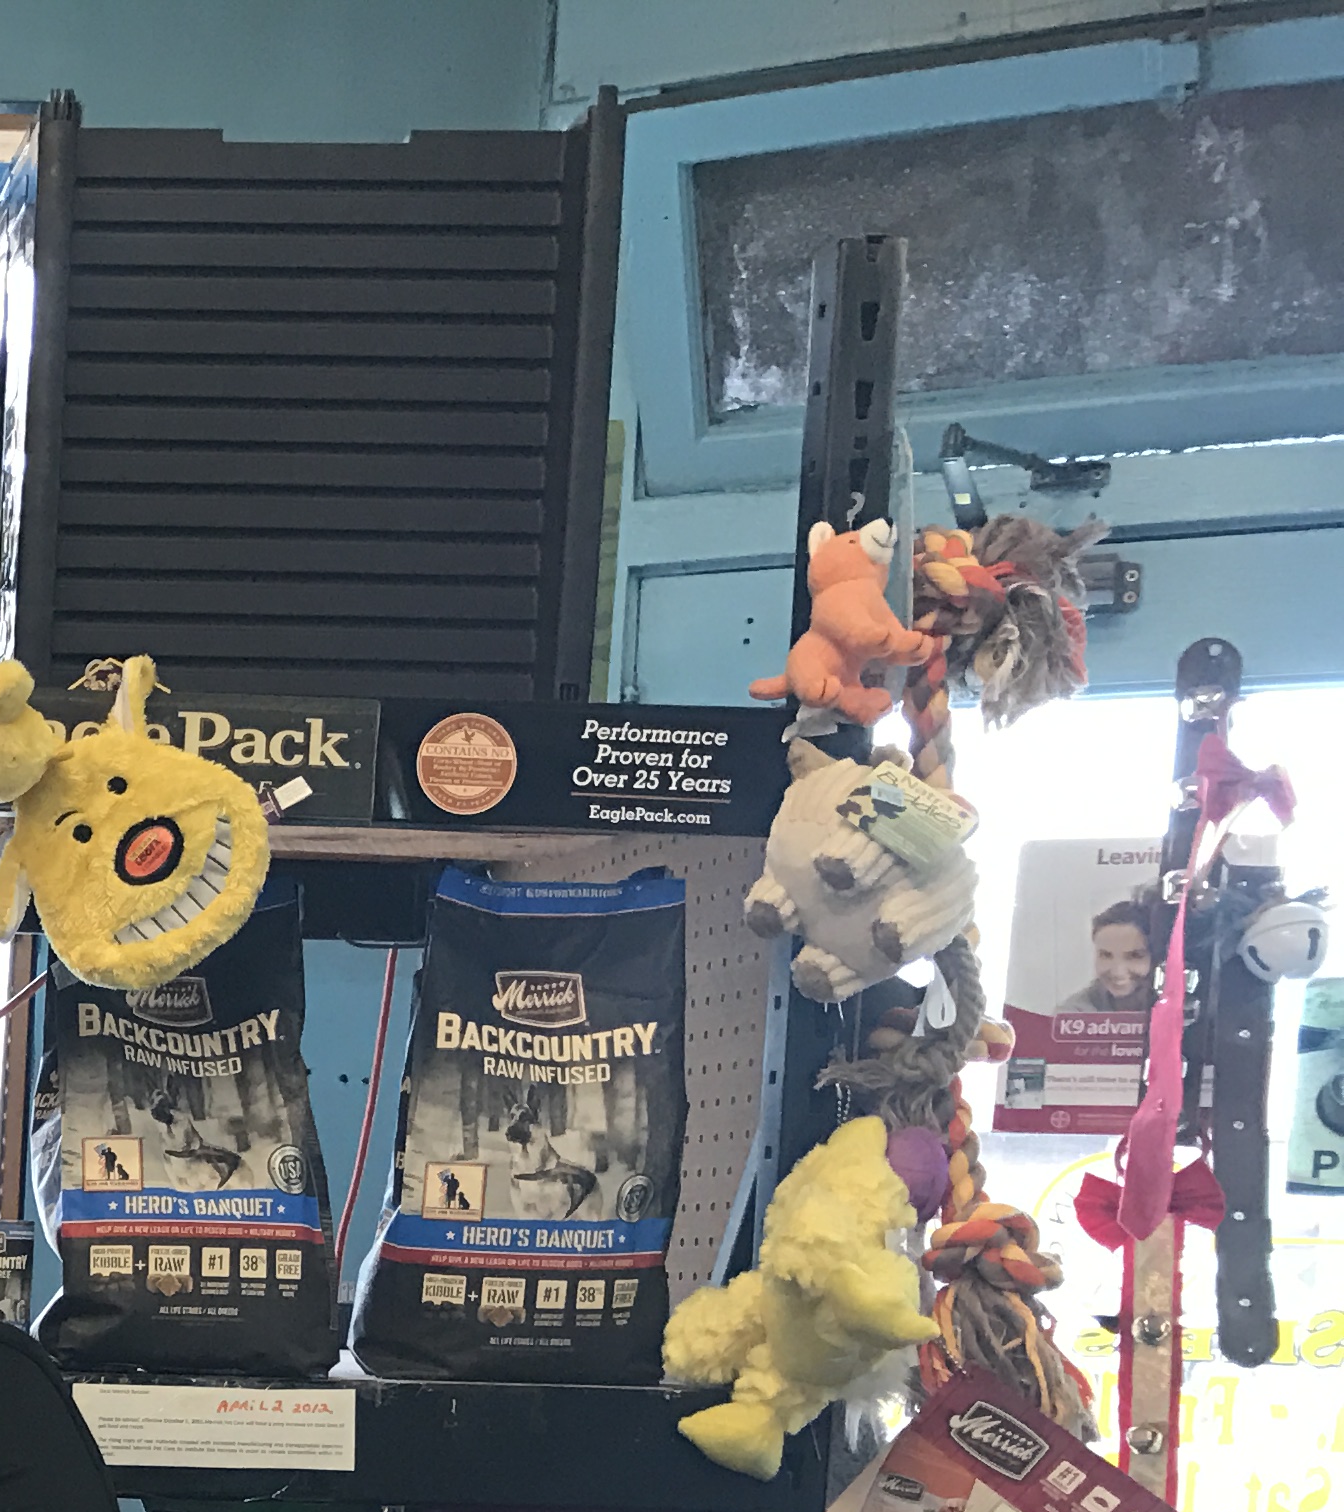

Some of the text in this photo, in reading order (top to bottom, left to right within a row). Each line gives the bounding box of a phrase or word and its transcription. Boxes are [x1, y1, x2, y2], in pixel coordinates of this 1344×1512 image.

[581, 719, 729, 747] Performance
[426, 745, 511, 757] CONTAINS NO
[594, 744, 712, 768] Proven for
[572, 767, 732, 794] Over 25 Years
[589, 805, 711, 825] EaglePack.com
[78, 1003, 281, 1059] BACKCOUNTRY
[436, 1011, 659, 1063] BACKCOUNTRY
[483, 1055, 611, 1085] RAW INFUSED
[124, 1195, 274, 1220] HERO'S BANQUET
[271, 1400, 283, 1413] 2
